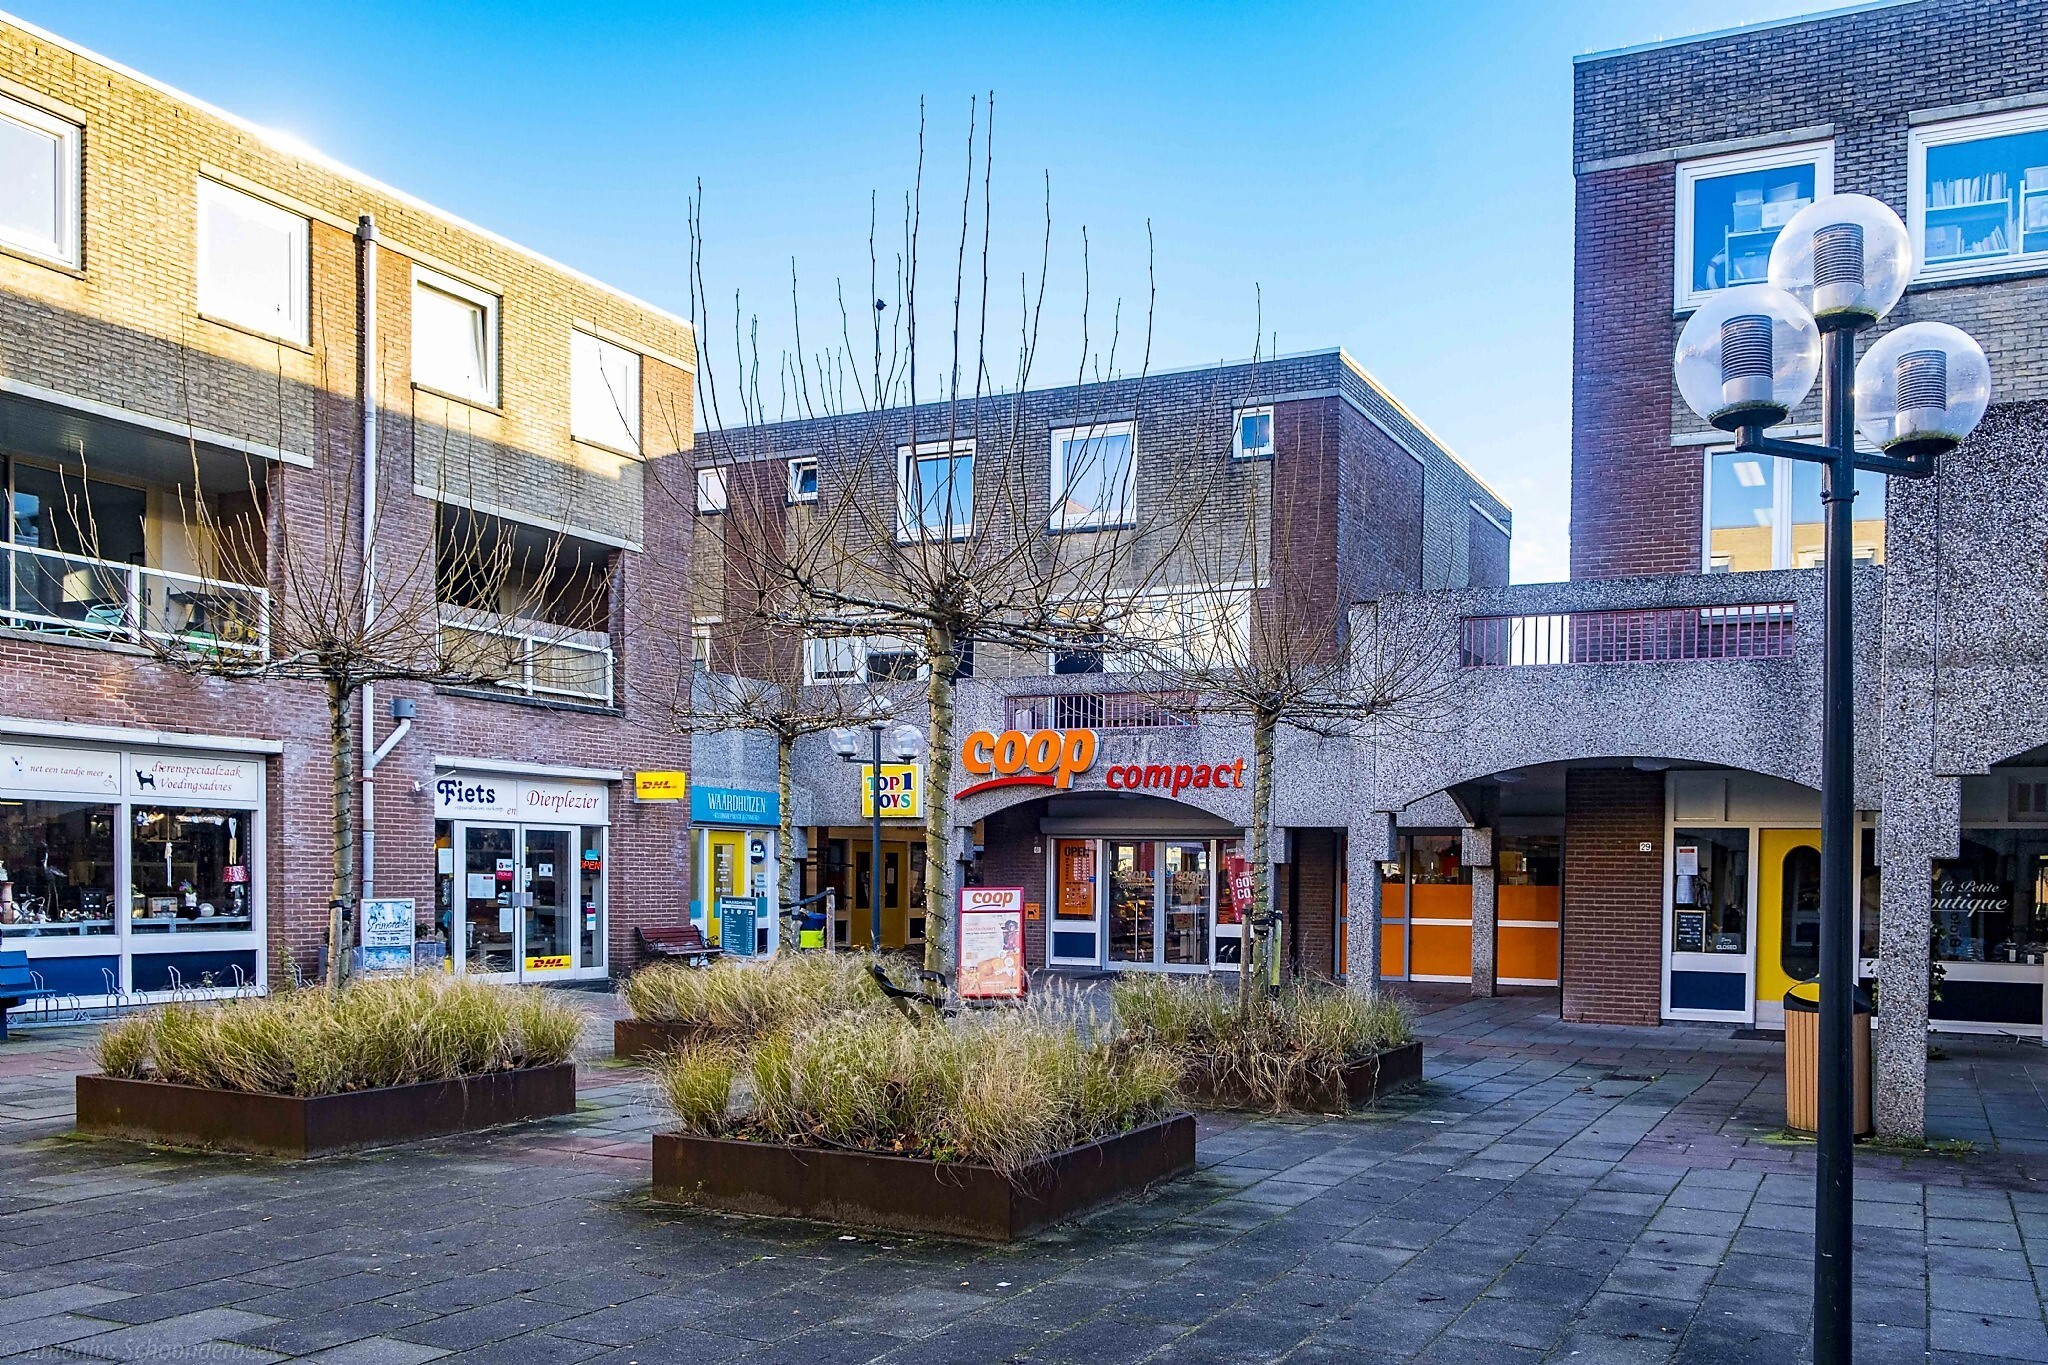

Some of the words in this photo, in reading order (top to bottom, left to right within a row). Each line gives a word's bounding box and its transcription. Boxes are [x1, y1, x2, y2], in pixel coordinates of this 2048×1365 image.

[961, 728, 1099, 789] coop
[60, 767, 85, 778] tandje
[151, 761, 243, 779] dierenspeciaalzaak
[1105, 758, 1248, 797] compact
[159, 777, 232, 793] Voedingsadvies
[436, 779, 496, 806] Fiets
[641, 781, 671, 789] DHL
[527, 789, 600, 813] Dierplezier
[707, 792, 766, 813] WAARDHUIZEN
[869, 794, 911, 808] OYS
[506, 807, 517, 815] en
[1640, 843, 1651, 851] 29
[1958, 880, 2000, 893] Petite
[972, 891, 1014, 907] coop
[533, 958, 564, 968] DHL
